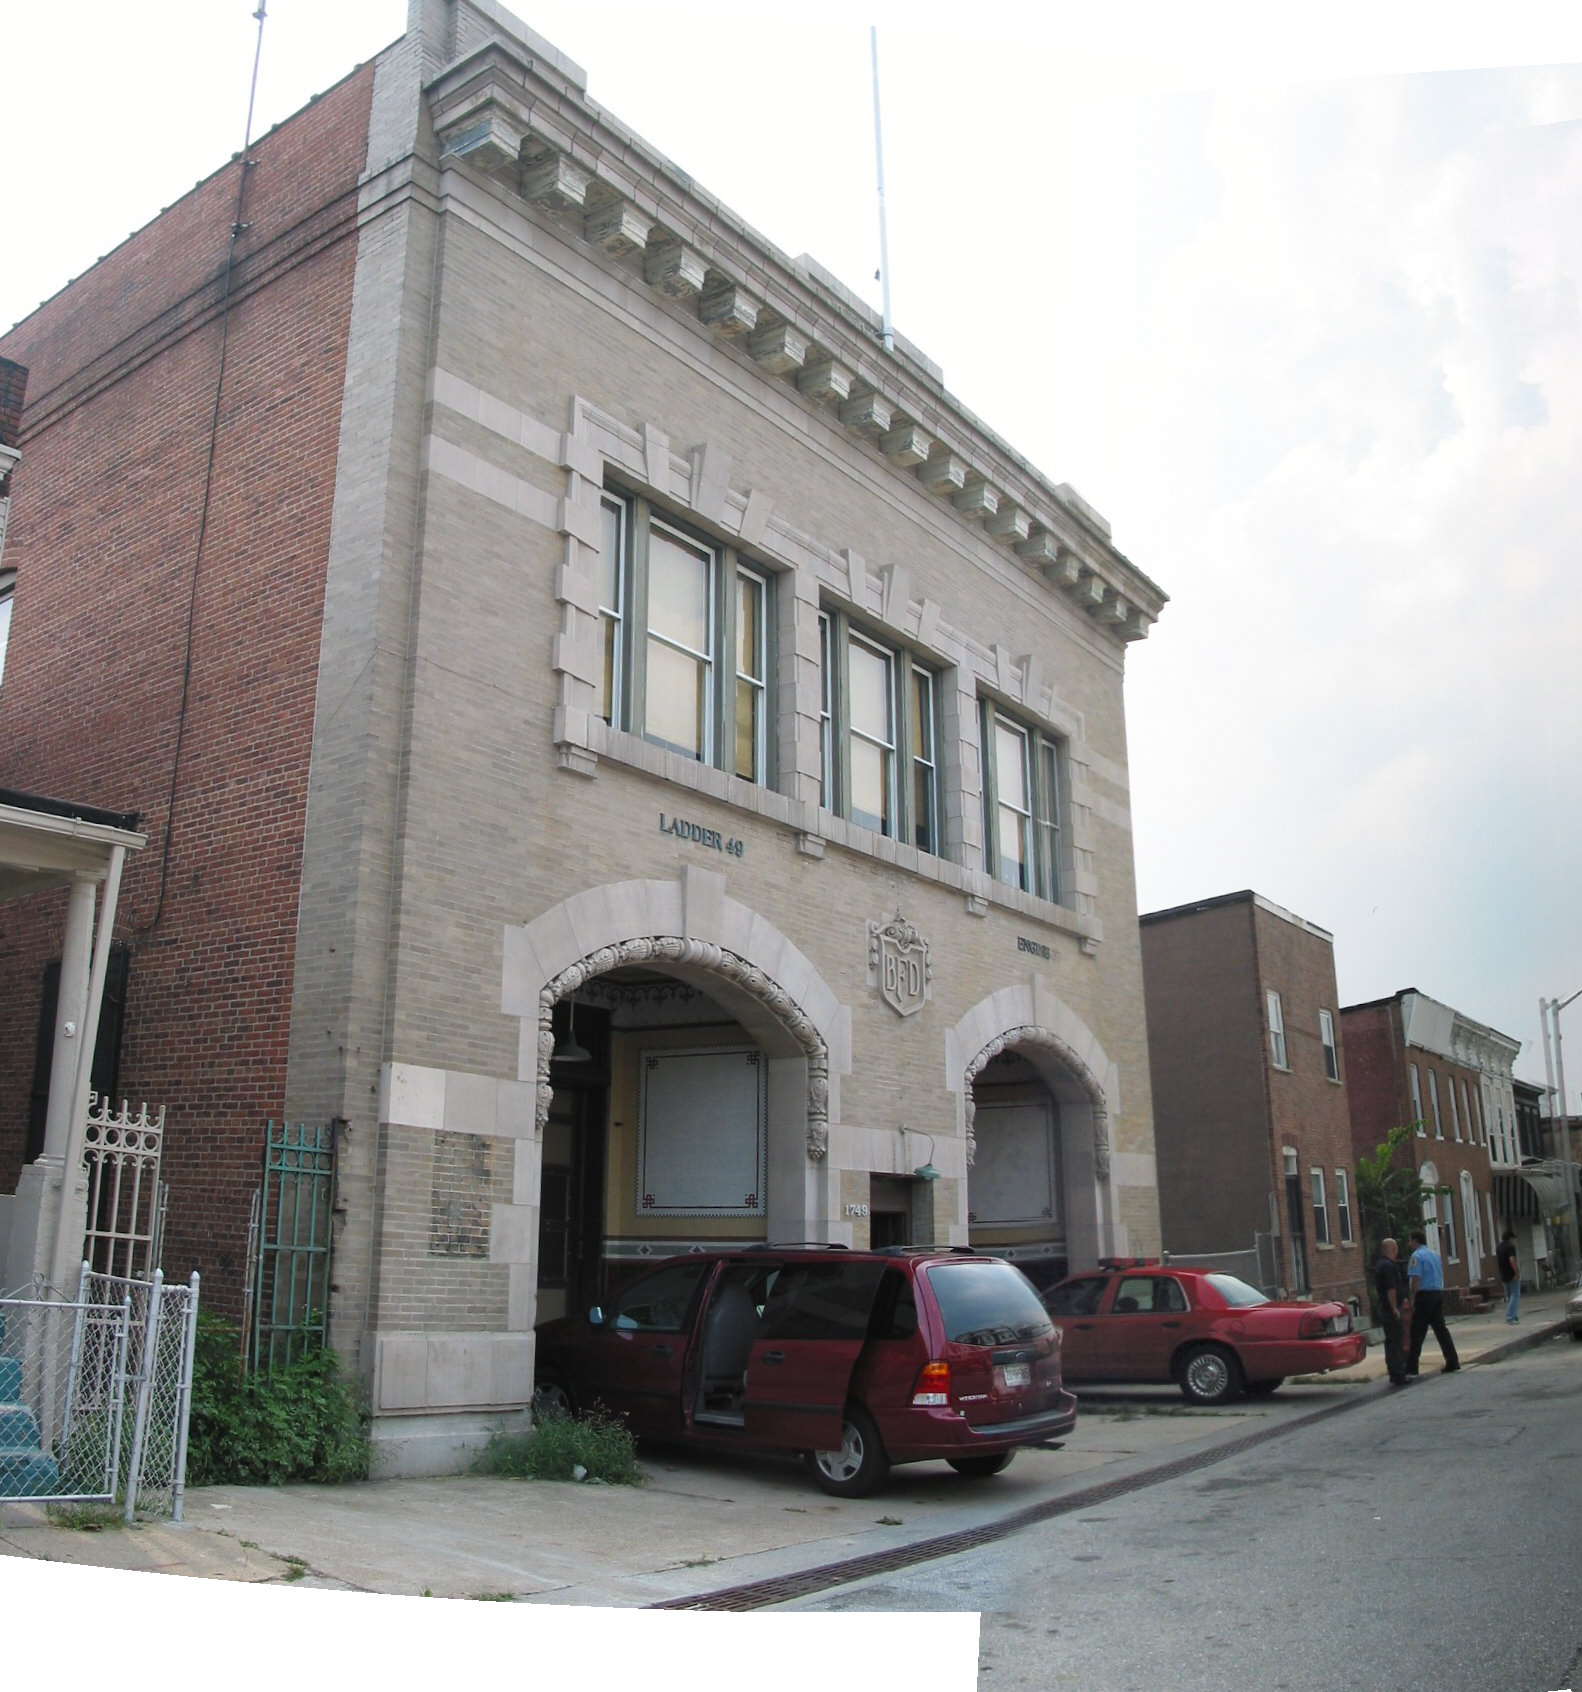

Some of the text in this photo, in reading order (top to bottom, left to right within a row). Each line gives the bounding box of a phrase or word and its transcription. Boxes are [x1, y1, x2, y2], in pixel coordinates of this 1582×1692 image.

[660, 812, 743, 858] LADDER 49
[884, 952, 920, 1000] BFD
[845, 1204, 868, 1217] 1749
